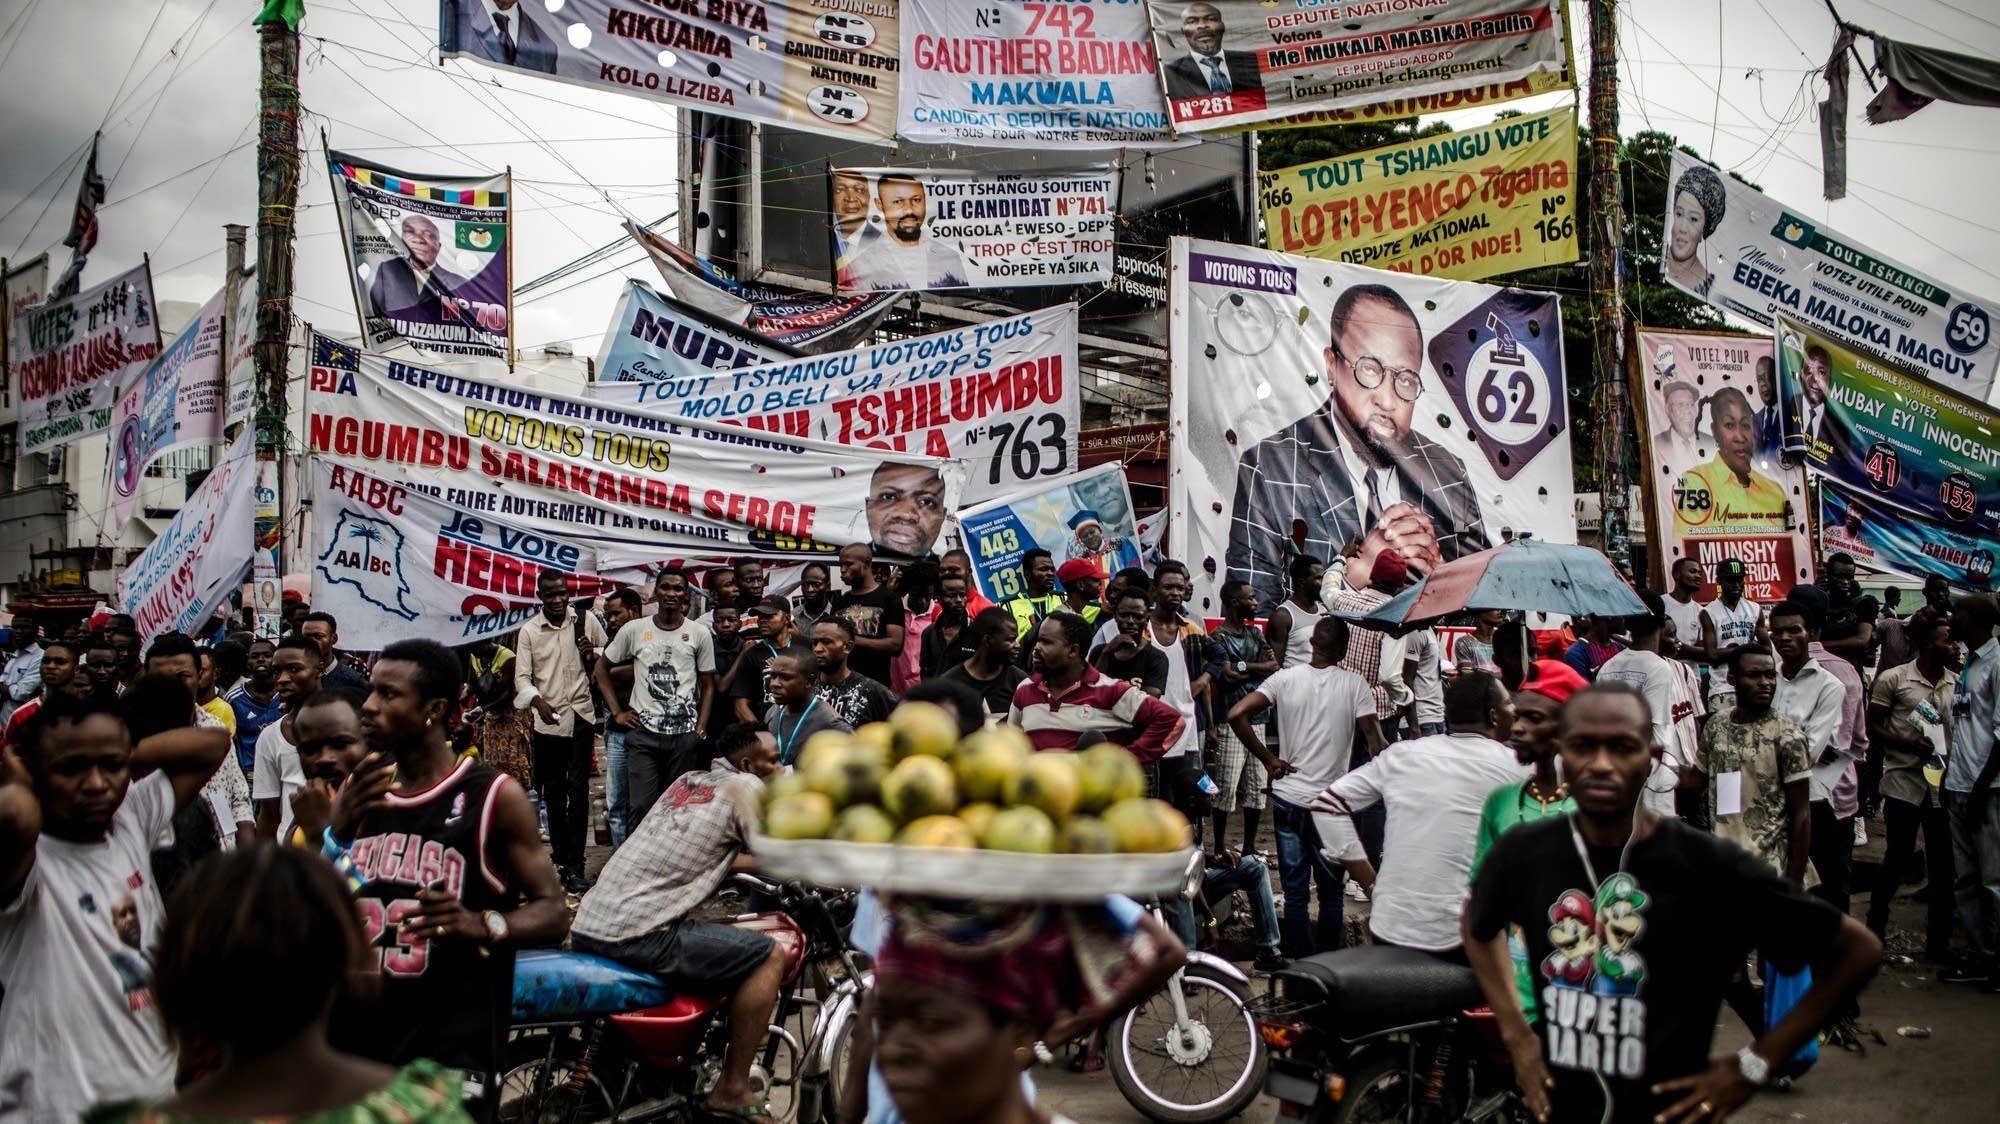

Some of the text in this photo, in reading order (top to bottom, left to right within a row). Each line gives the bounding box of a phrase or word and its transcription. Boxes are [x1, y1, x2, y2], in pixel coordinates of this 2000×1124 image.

[607, 7, 733, 60] KIKUAMA
[1023, 4, 1096, 38] 742
[1267, 9, 1340, 30] DEPUTE
[819, 30, 867, 46] 66
[1268, 14, 1535, 68] Me MUKALA MABIKA Paulin
[1272, 29, 1324, 46] Votons
[784, 41, 857, 65] CANDIDAT
[914, 34, 1157, 76] GAUTHIER BADIAN
[1336, 66, 1350, 77] LE
[1354, 59, 1397, 75] PEUPLE
[600, 62, 735, 106] KOLO LIZIBA
[810, 66, 878, 89] NATIONAL
[1286, 55, 1505, 101] Tous pour le changement
[971, 81, 1115, 106] MAKWALA
[820, 103, 855, 120] 74
[914, 106, 1000, 127] CANDIDAT
[1007, 110, 1082, 129] DEPUTE
[992, 127, 1026, 141] POUR
[1035, 129, 1079, 142] NOTRE
[1299, 116, 1550, 192] TOUT TSHANGU VOTE
[926, 180, 1112, 197] TOUT TSHANGU SOUTIENT
[1262, 187, 1293, 209] 166
[937, 201, 958, 220] LE
[960, 198, 1052, 220] CANDIDAT
[1281, 159, 1569, 252] LOTI-YENGO Tigana
[932, 221, 1066, 239] SONGOLA EWESO
[1340, 212, 1490, 264] DEPUTE NATIONAL
[1534, 214, 1574, 244] 166
[971, 243, 1016, 258] TROP
[1071, 239, 1114, 255] TROP
[1738, 245, 1786, 276] Maman
[986, 260, 1100, 278] MOPEPE YA SIKA
[1204, 261, 1293, 290] VOTONS TOUS
[1826, 241, 1937, 299] TOUT TSHANGU
[1816, 260, 1929, 318] VOTEZ UTILE POUR
[472, 300, 507, 331] 70
[1732, 261, 1802, 311] EBEKA
[1804, 295, 1891, 350] MALOKA
[1896, 332, 1976, 380] MAGUY
[1812, 281, 1913, 330] MONGONGO YA BANA TSHANGU
[409, 321, 467, 343] NZAKUM
[1951, 312, 1987, 347] 59
[637, 315, 1034, 403] TOUT TSHANGU VOTONS TOUS
[1688, 346, 1750, 364] VOTEZ POUR
[387, 360, 543, 411] DEPUTATION
[547, 399, 682, 436] NATIONALE
[680, 393, 755, 418] MOLO
[847, 373, 882, 397] YA
[832, 354, 1064, 445] TSHILUMBU
[1477, 368, 1538, 425] 62
[1856, 360, 1899, 385] ENSEMBLE
[1934, 394, 1991, 425] CHANGEMENT
[1904, 396, 1939, 420] VOTEZ
[464, 405, 672, 473] VOTONS TOUS
[1830, 383, 2000, 468] MUBAY EYI INNOCENT
[1855, 423, 1887, 441] PROVINCIAL
[988, 412, 1067, 485] 763
[310, 411, 817, 540] NGUMBU SALAKANDA SERGE
[1867, 451, 1898, 487] 41
[1939, 458, 1987, 481] NATIONAL TSHANGU
[329, 463, 408, 516] AABC
[1674, 488, 1712, 511] 758
[1941, 481, 1976, 514] 152
[440, 511, 484, 541] Je
[447, 487, 497, 512] FAIRE
[500, 498, 611, 527] AUTREMENT
[612, 510, 635, 529] LA
[637, 516, 730, 542] POLITIQUE
[967, 521, 993, 534] CANDIDAT
[980, 524, 1006, 535] NATIONAL
[980, 528, 1020, 558] 443
[1698, 540, 1779, 564] MUNSHY
[1920, 541, 1992, 574] TSHANGU 648
[334, 549, 392, 577] AA BC
[979, 556, 1005, 568] CANDIDAT
[989, 557, 1020, 571] PROVINCIAL
[1542, 985, 1647, 1038] SUPER
